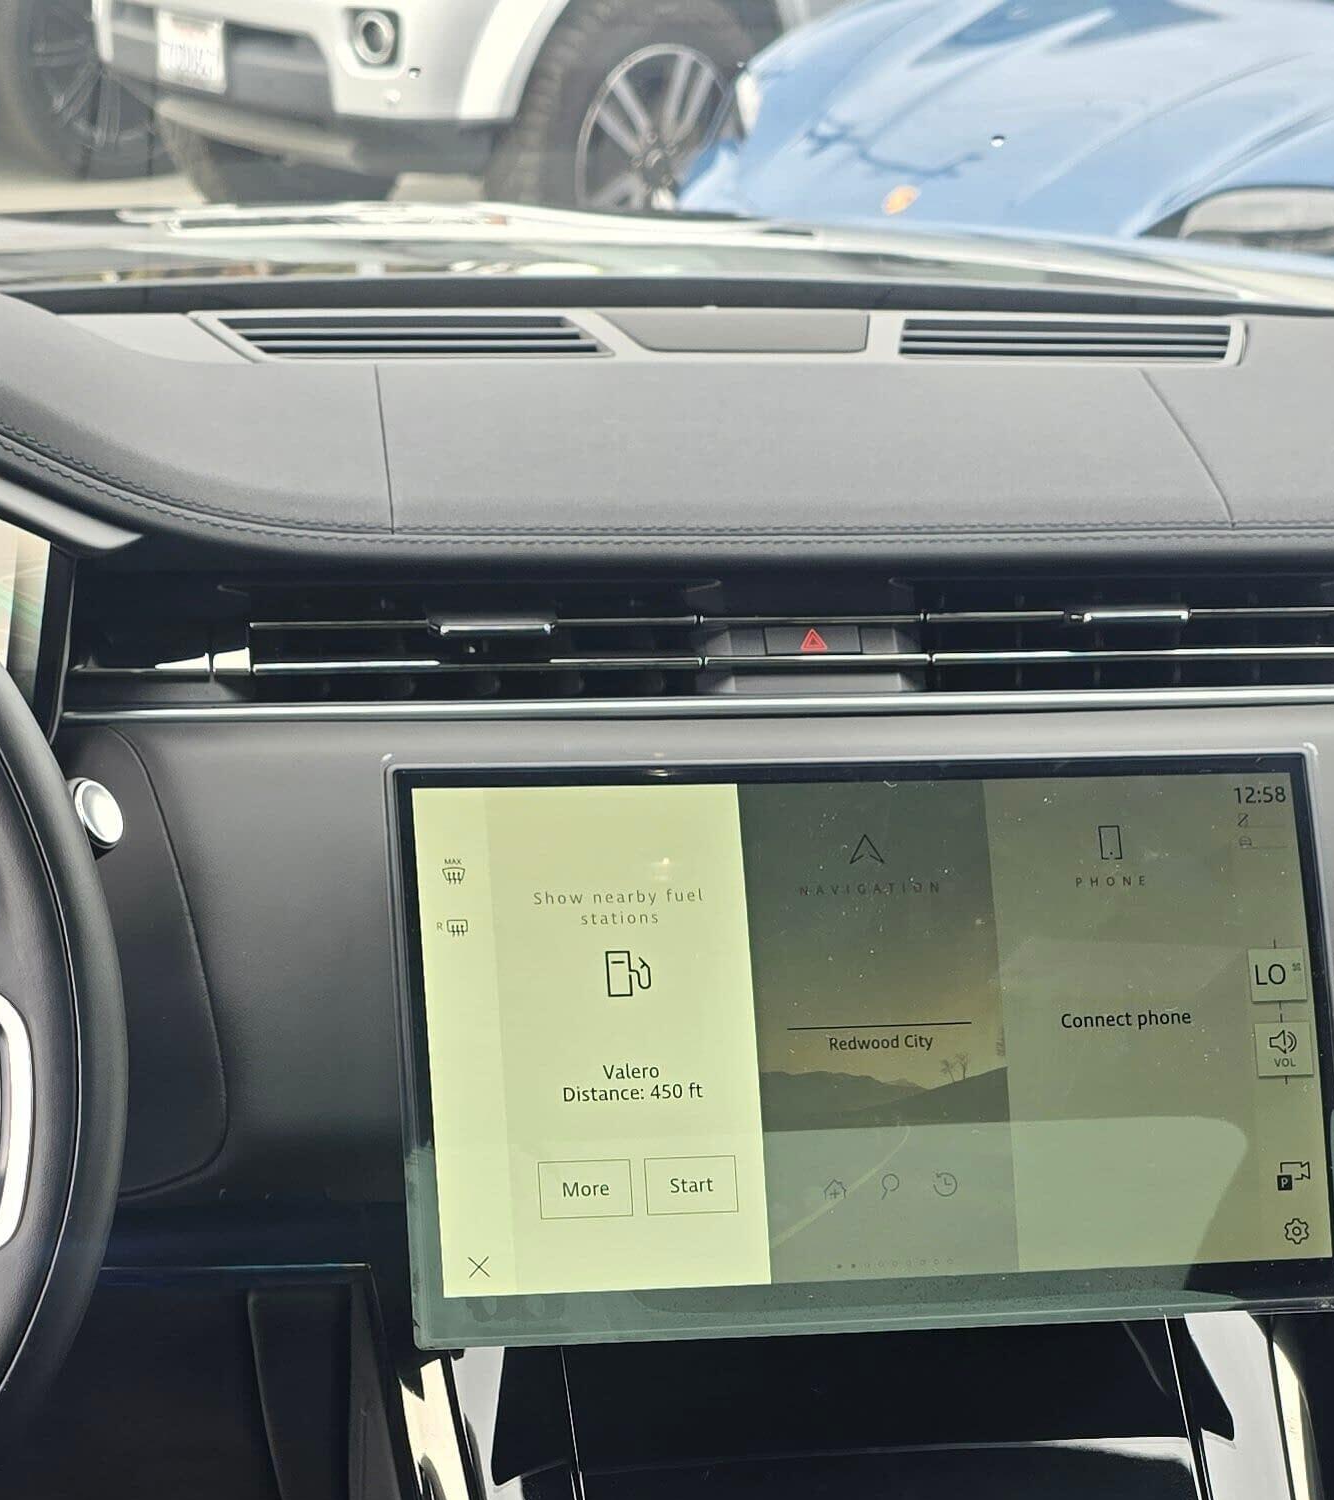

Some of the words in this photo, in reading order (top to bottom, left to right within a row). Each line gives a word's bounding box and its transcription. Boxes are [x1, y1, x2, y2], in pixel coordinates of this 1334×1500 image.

[1232, 785, 1287, 807] 12:58
[443, 857, 463, 866] MAX
[798, 881, 941, 897] NAVIGATION
[1074, 875, 1148, 889] PHONE
[533, 890, 584, 906] Show
[592, 888, 658, 907] nearby
[665, 886, 706, 904] fuel
[436, 920, 444, 932] R
[580, 910, 660, 926] stations
[1254, 963, 1287, 986] LO
[1060, 1011, 1133, 1029] Connect
[1137, 1008, 1192, 1030] phone
[828, 1034, 900, 1053] Redwood
[903, 1032, 934, 1056] City
[1273, 1056, 1297, 1068] VOL
[602, 1063, 660, 1081] Valero
[562, 1084, 645, 1103] Distance:
[649, 1083, 684, 1100] 450
[688, 1082, 704, 1099] ft
[562, 1179, 611, 1198] More
[669, 1175, 714, 1194] Start
